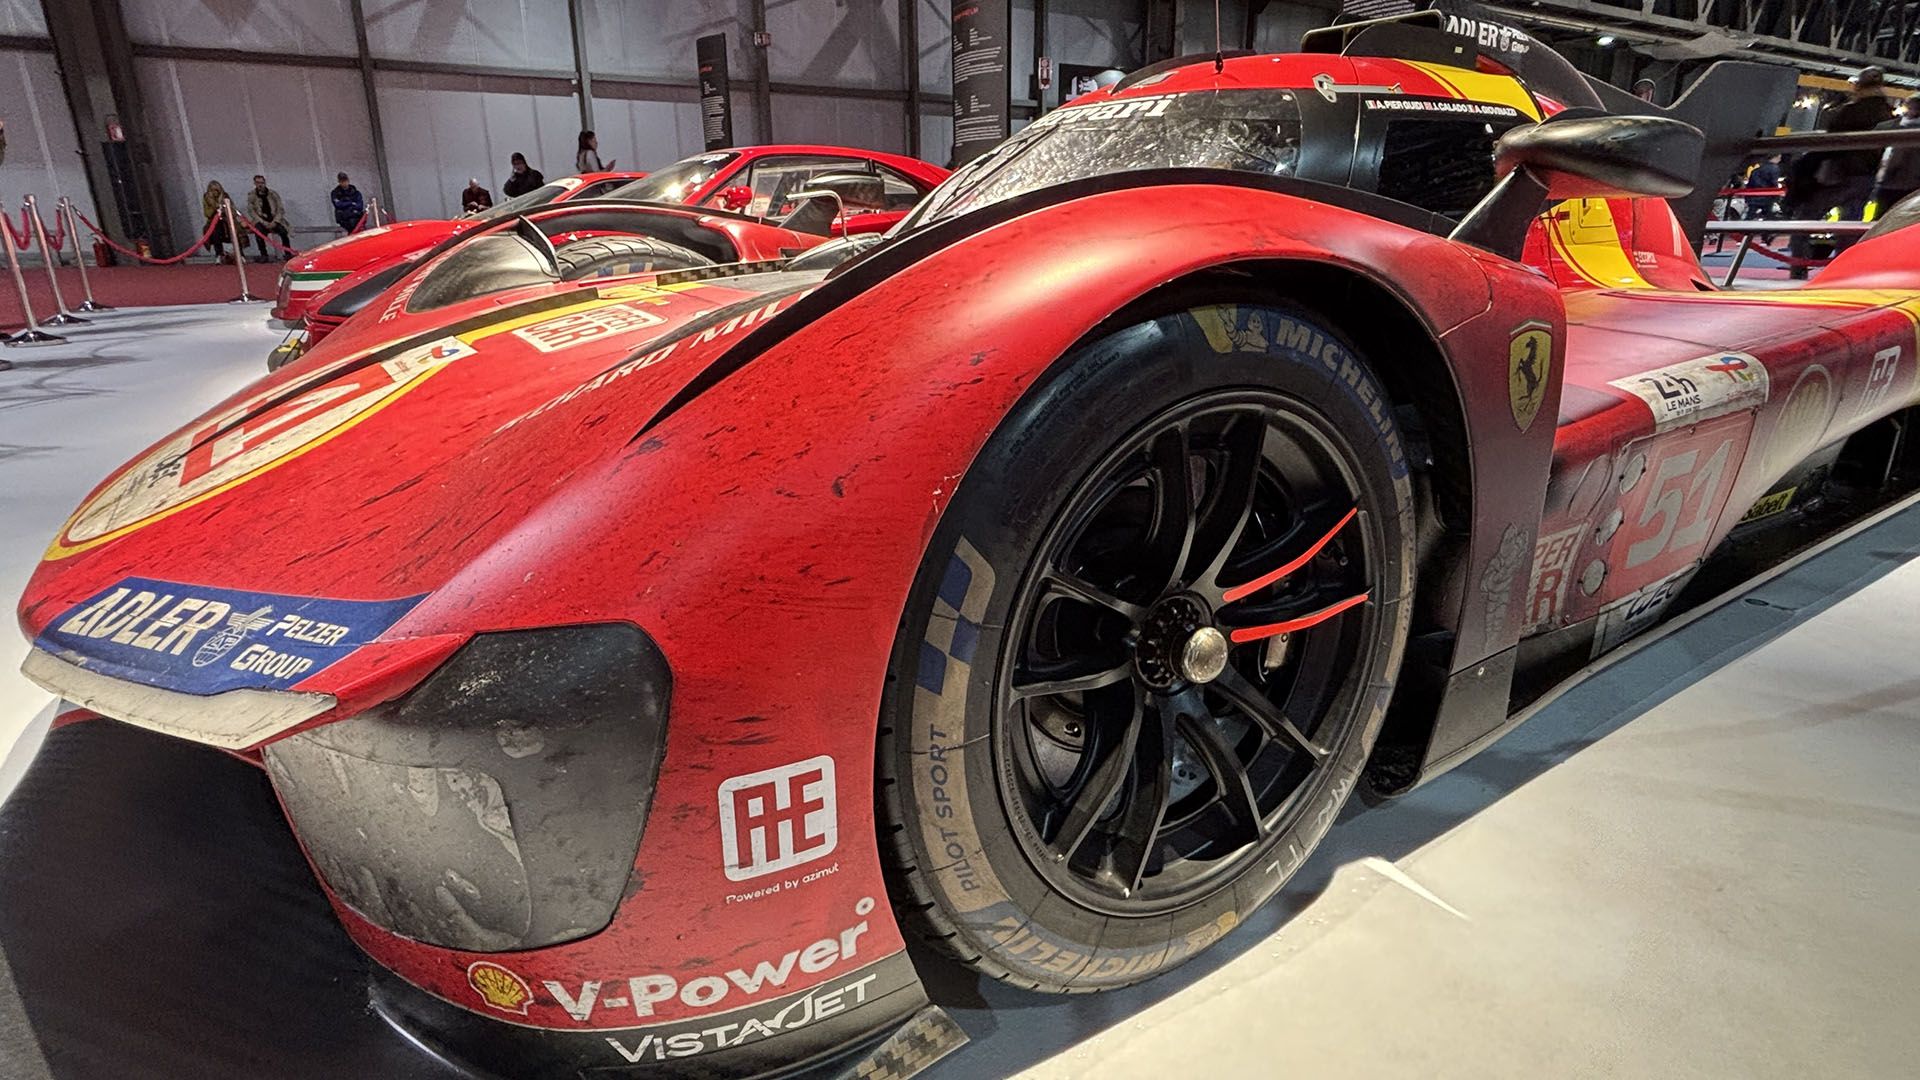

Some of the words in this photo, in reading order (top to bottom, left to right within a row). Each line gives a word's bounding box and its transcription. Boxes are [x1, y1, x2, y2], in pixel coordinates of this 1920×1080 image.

[524, 315, 609, 348] CAR
[1275, 317, 1404, 464] MICHELIN
[1665, 400, 1677, 412] LE
[1678, 394, 1702, 409] MANS
[1625, 438, 1734, 569] 51
[57, 587, 231, 656] ADLER
[266, 613, 349, 647] PELZER
[230, 643, 313, 680] GROUP
[929, 722, 954, 819] SPORT
[725, 883, 780, 905] Powered
[785, 879, 800, 889] by
[802, 862, 839, 883] azimut
[940, 827, 981, 892] PILOT
[543, 920, 869, 1021] V-Power
